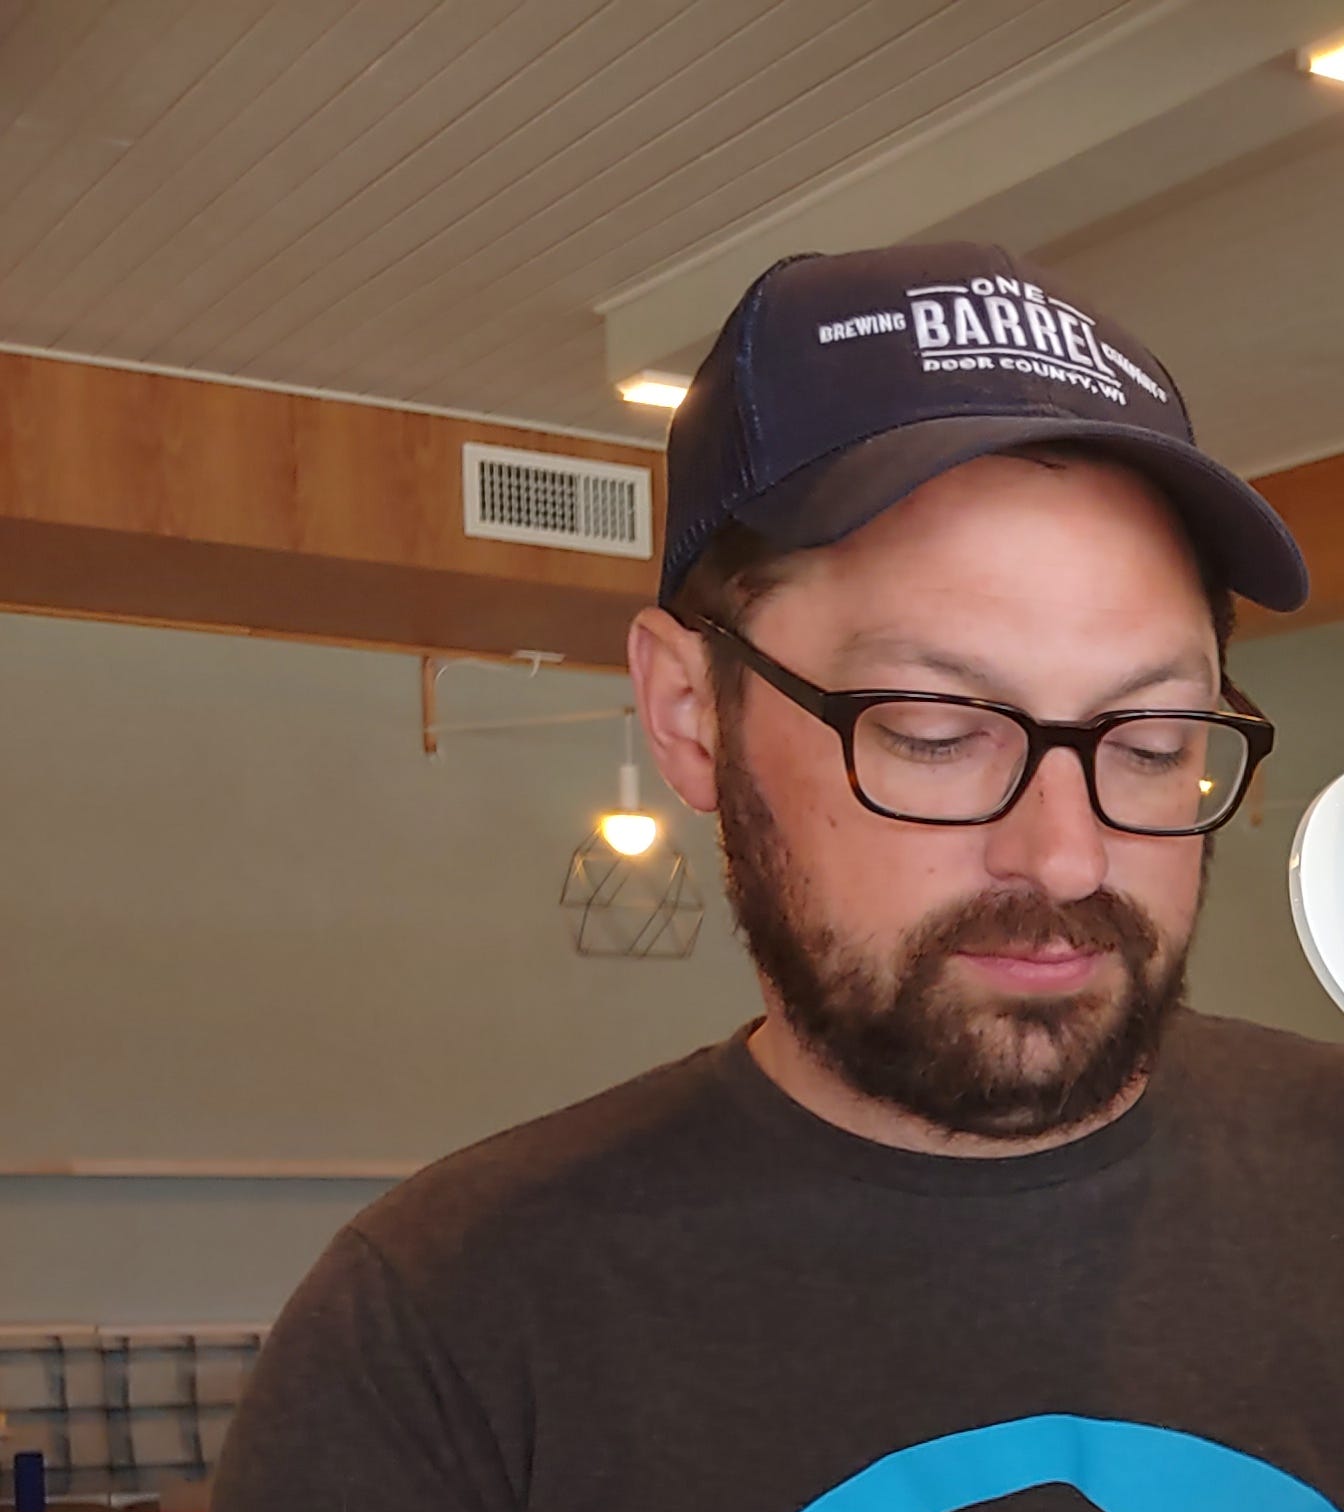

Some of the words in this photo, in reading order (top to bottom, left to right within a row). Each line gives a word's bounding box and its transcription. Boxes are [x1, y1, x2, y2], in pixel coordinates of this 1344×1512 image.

[970, 275, 1047, 304] ONE
[817, 311, 907, 345] BREWING
[910, 296, 1117, 377] BARREL
[923, 358, 996, 373] DOOR
[1097, 381, 1127, 406] WI
